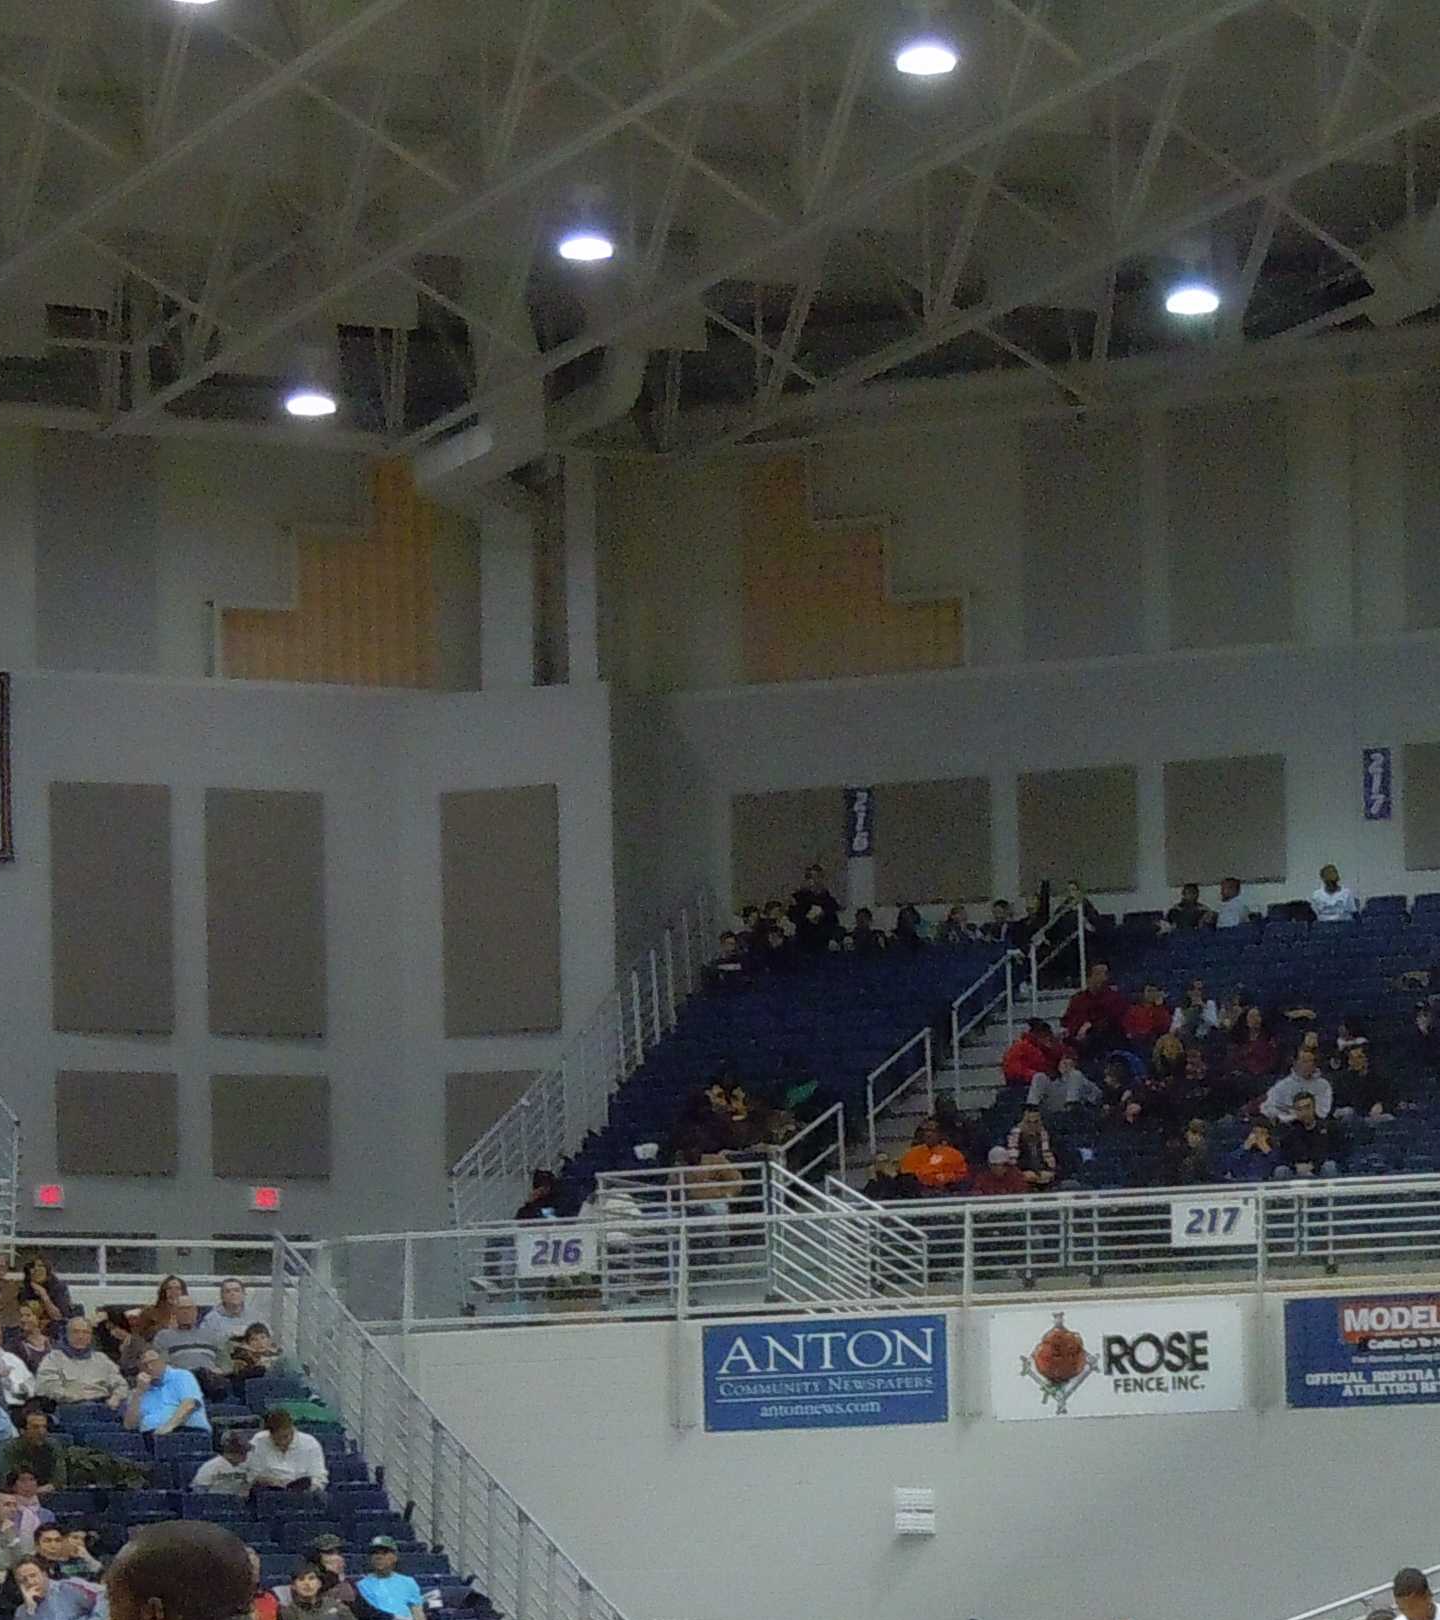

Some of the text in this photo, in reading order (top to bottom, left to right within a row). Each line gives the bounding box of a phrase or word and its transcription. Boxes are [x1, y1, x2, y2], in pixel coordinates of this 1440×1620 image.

[1368, 753, 1385, 814] 217
[1185, 1207, 1240, 1234] 217
[531, 1239, 582, 1265] 216
[717, 1328, 936, 1374] ANTON
[1103, 1330, 1209, 1376] ROSE
[1172, 1375, 1206, 1390] INC.
[1305, 1371, 1366, 1386] OFFICIAL
[1372, 1368, 1435, 1382] HOFSTRA
[1341, 1382, 1418, 1398] ATHLETICS
[760, 1400, 881, 1418] antonnews.com
